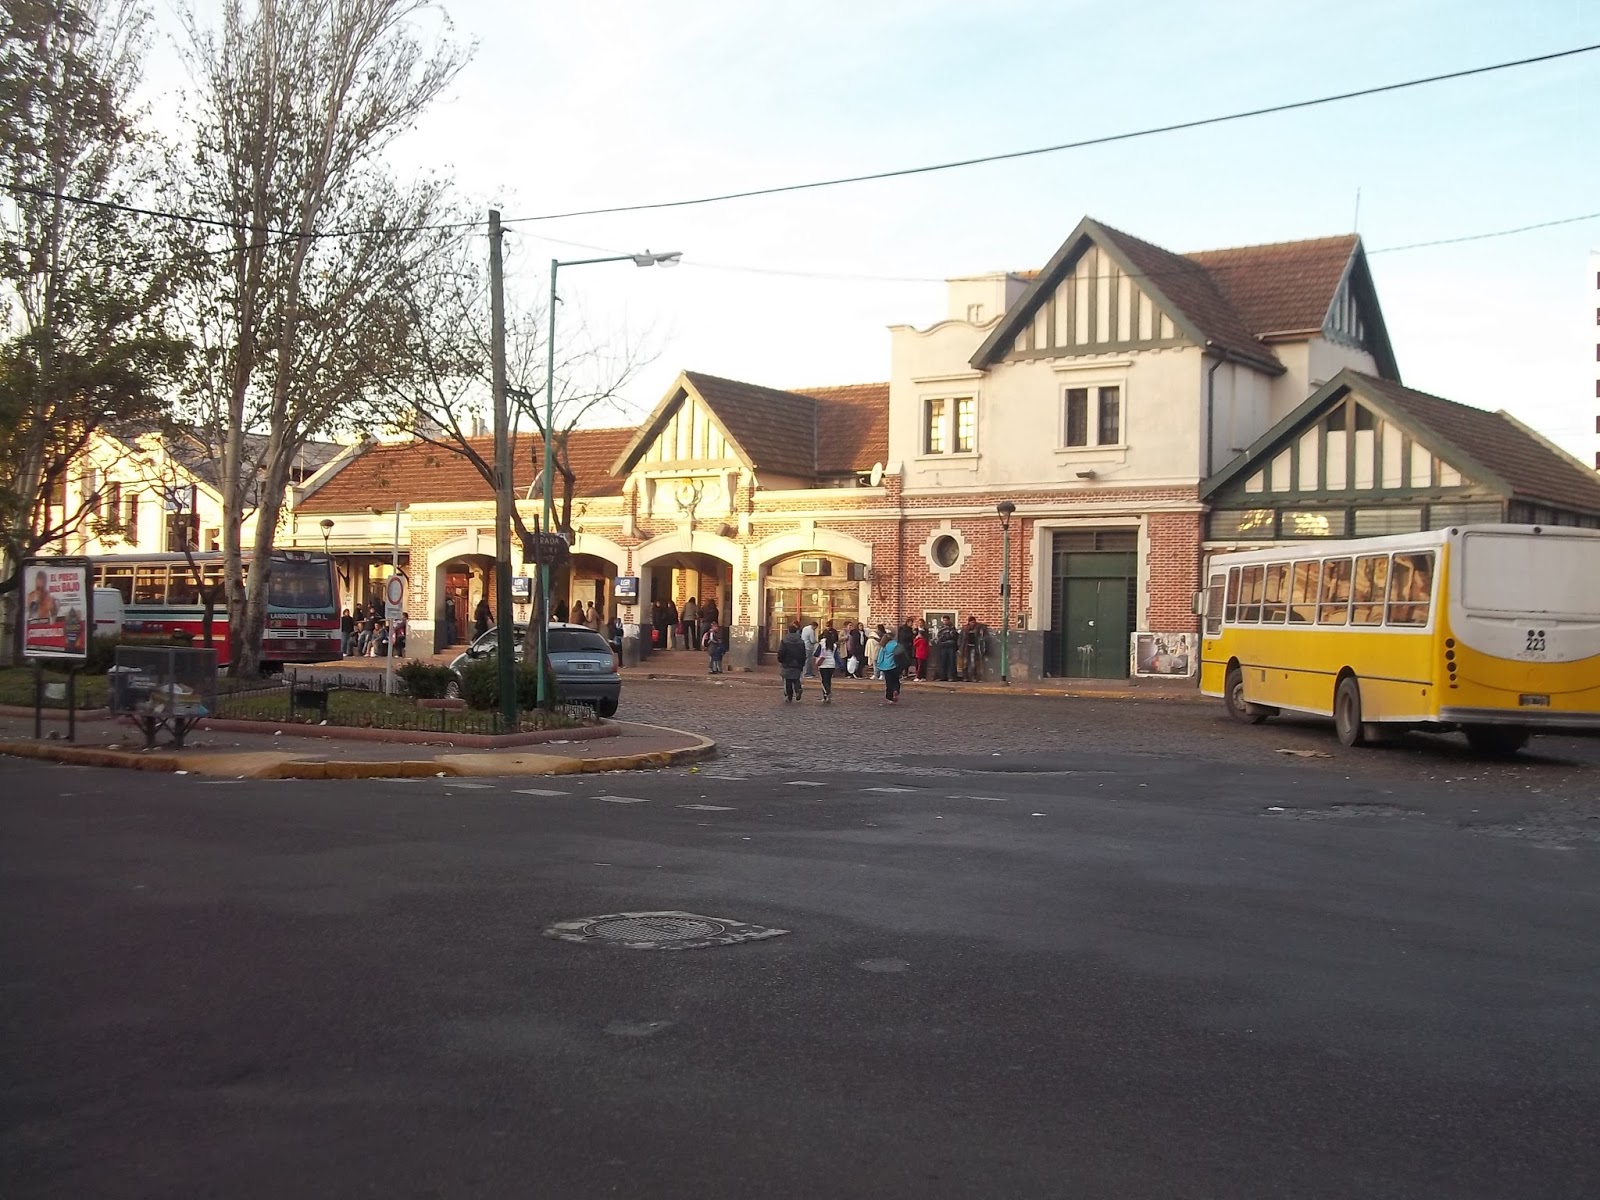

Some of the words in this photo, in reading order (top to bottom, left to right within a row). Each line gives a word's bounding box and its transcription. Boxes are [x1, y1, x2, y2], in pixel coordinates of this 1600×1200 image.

[50, 573, 57, 582] EL
[58, 572, 79, 581] PRECIO
[62, 581, 80, 593] BAJO
[1526, 637, 1546, 652] 223
